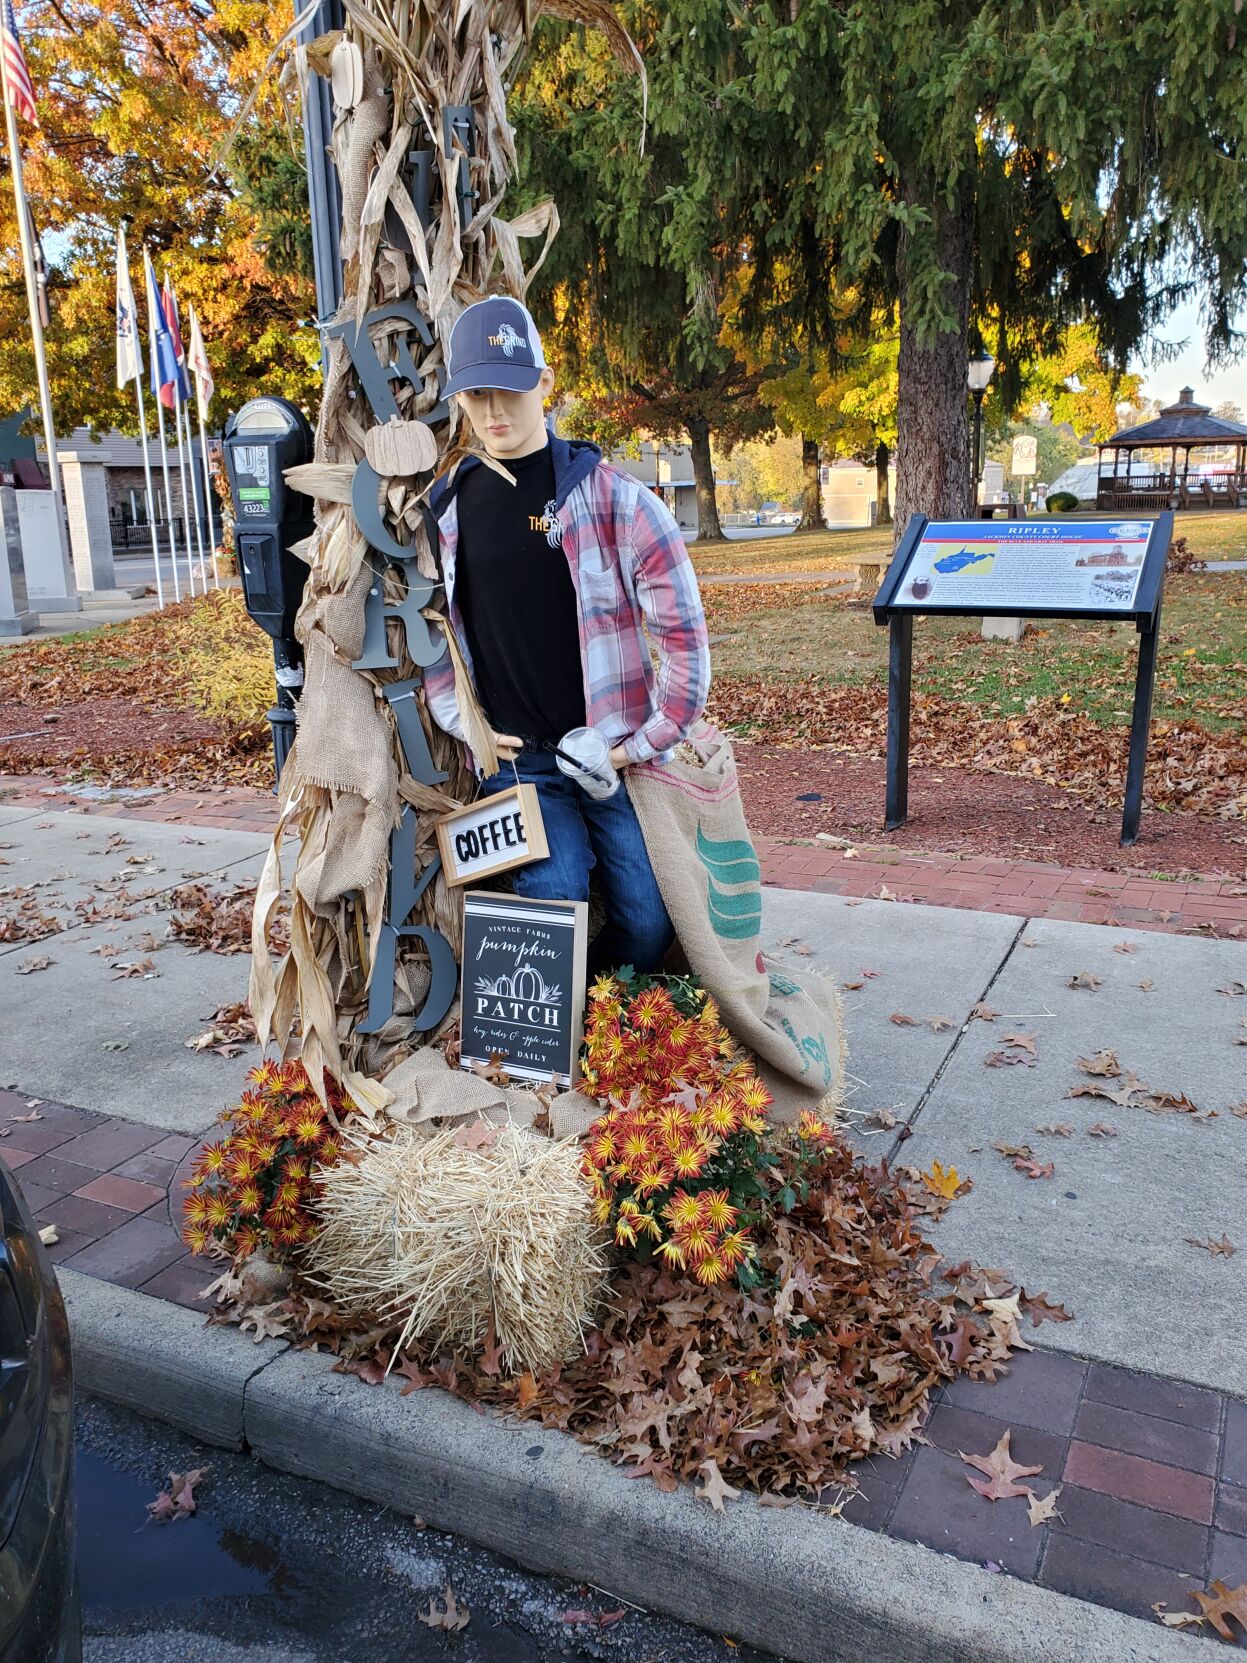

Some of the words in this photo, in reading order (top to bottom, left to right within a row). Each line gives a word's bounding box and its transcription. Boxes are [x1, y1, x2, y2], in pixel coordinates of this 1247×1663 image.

[244, 503, 264, 513] 43223
[528, 516, 550, 532] THE
[455, 812, 528, 863] COFFEE
[526, 928, 551, 940] FARMS
[475, 936, 562, 967] pumpkin
[476, 997, 559, 1026] PATCH
[473, 1026, 488, 1039] hay
[491, 1029, 508, 1039] rides
[522, 1035, 539, 1047] apple
[542, 1037, 559, 1047] cider
[485, 1045, 510, 1055] OPEN
[517, 1050, 547, 1062] DAILY
